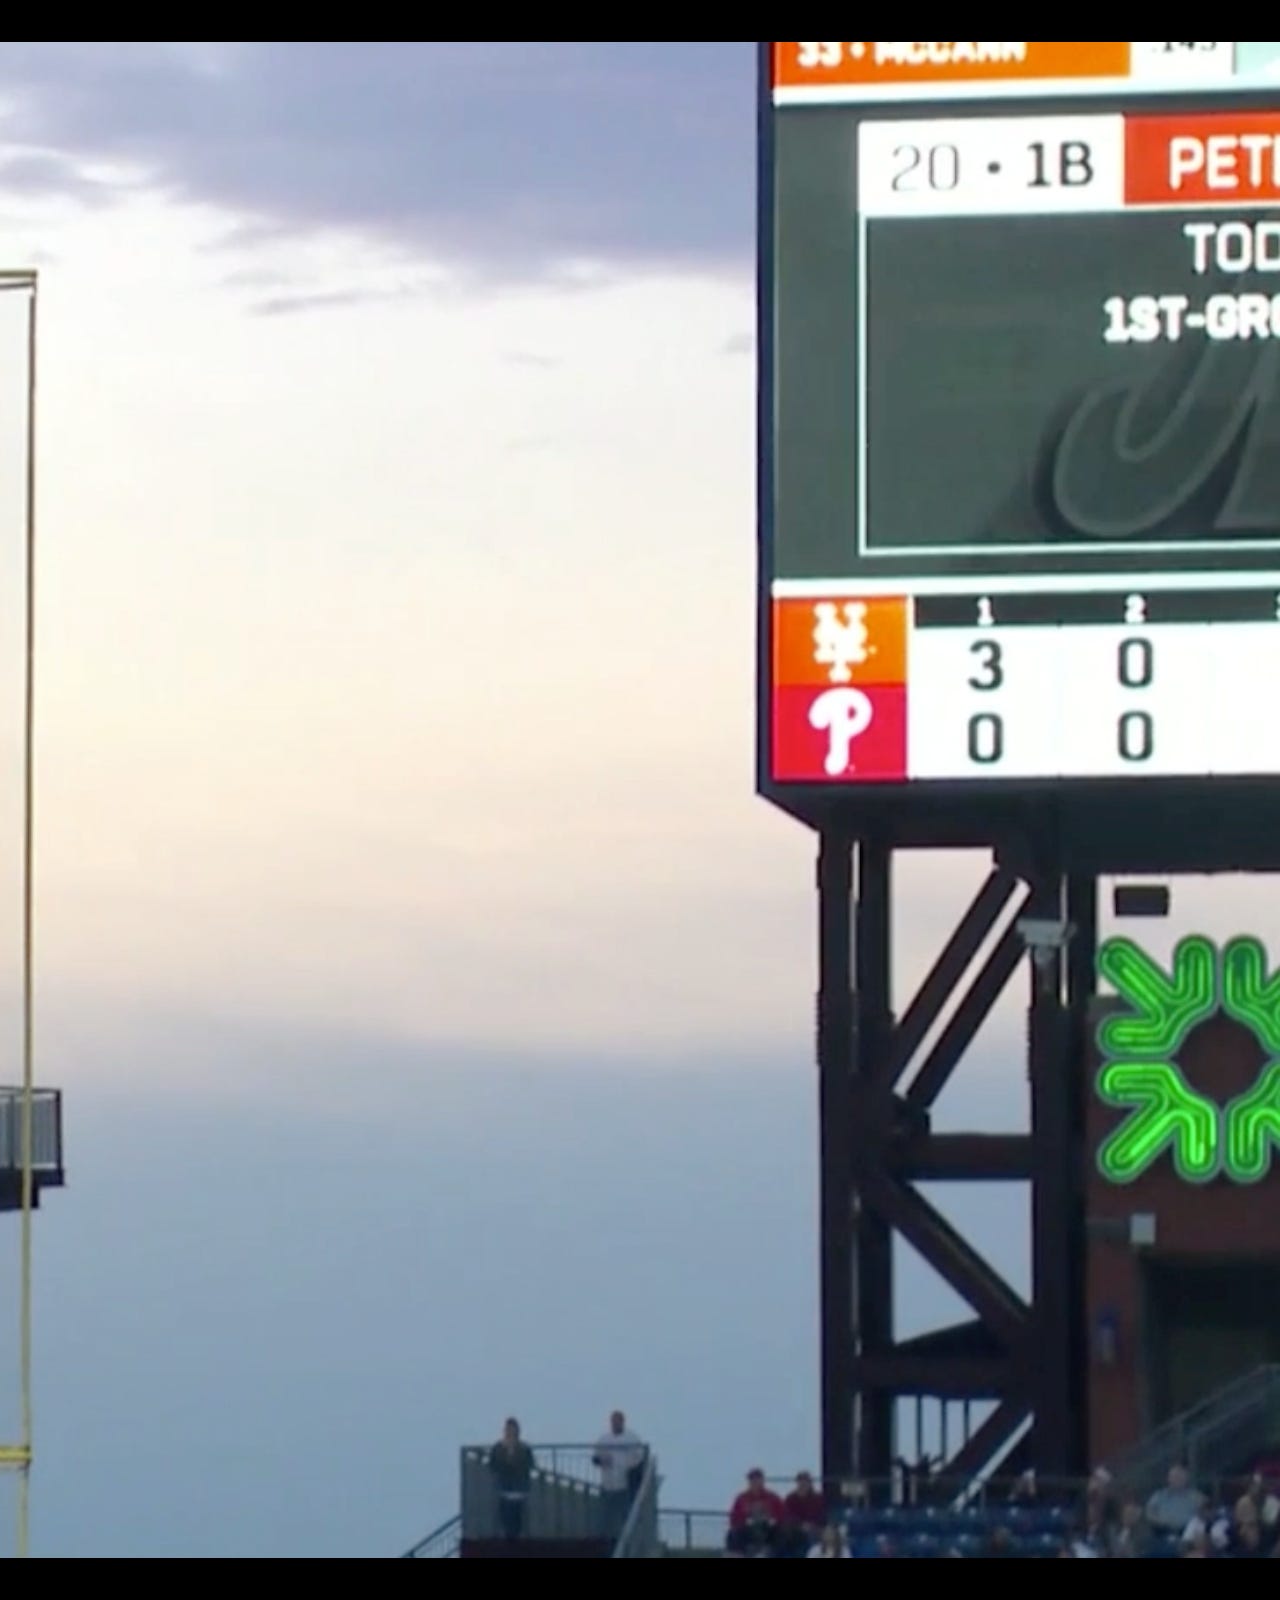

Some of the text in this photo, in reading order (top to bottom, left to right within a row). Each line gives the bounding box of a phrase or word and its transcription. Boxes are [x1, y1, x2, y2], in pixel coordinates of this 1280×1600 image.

[891, 140, 1094, 192] 20 1B
[977, 594, 1146, 625] 1 2
[968, 637, 1153, 691] 3 0
[968, 710, 1153, 764] 0 0
